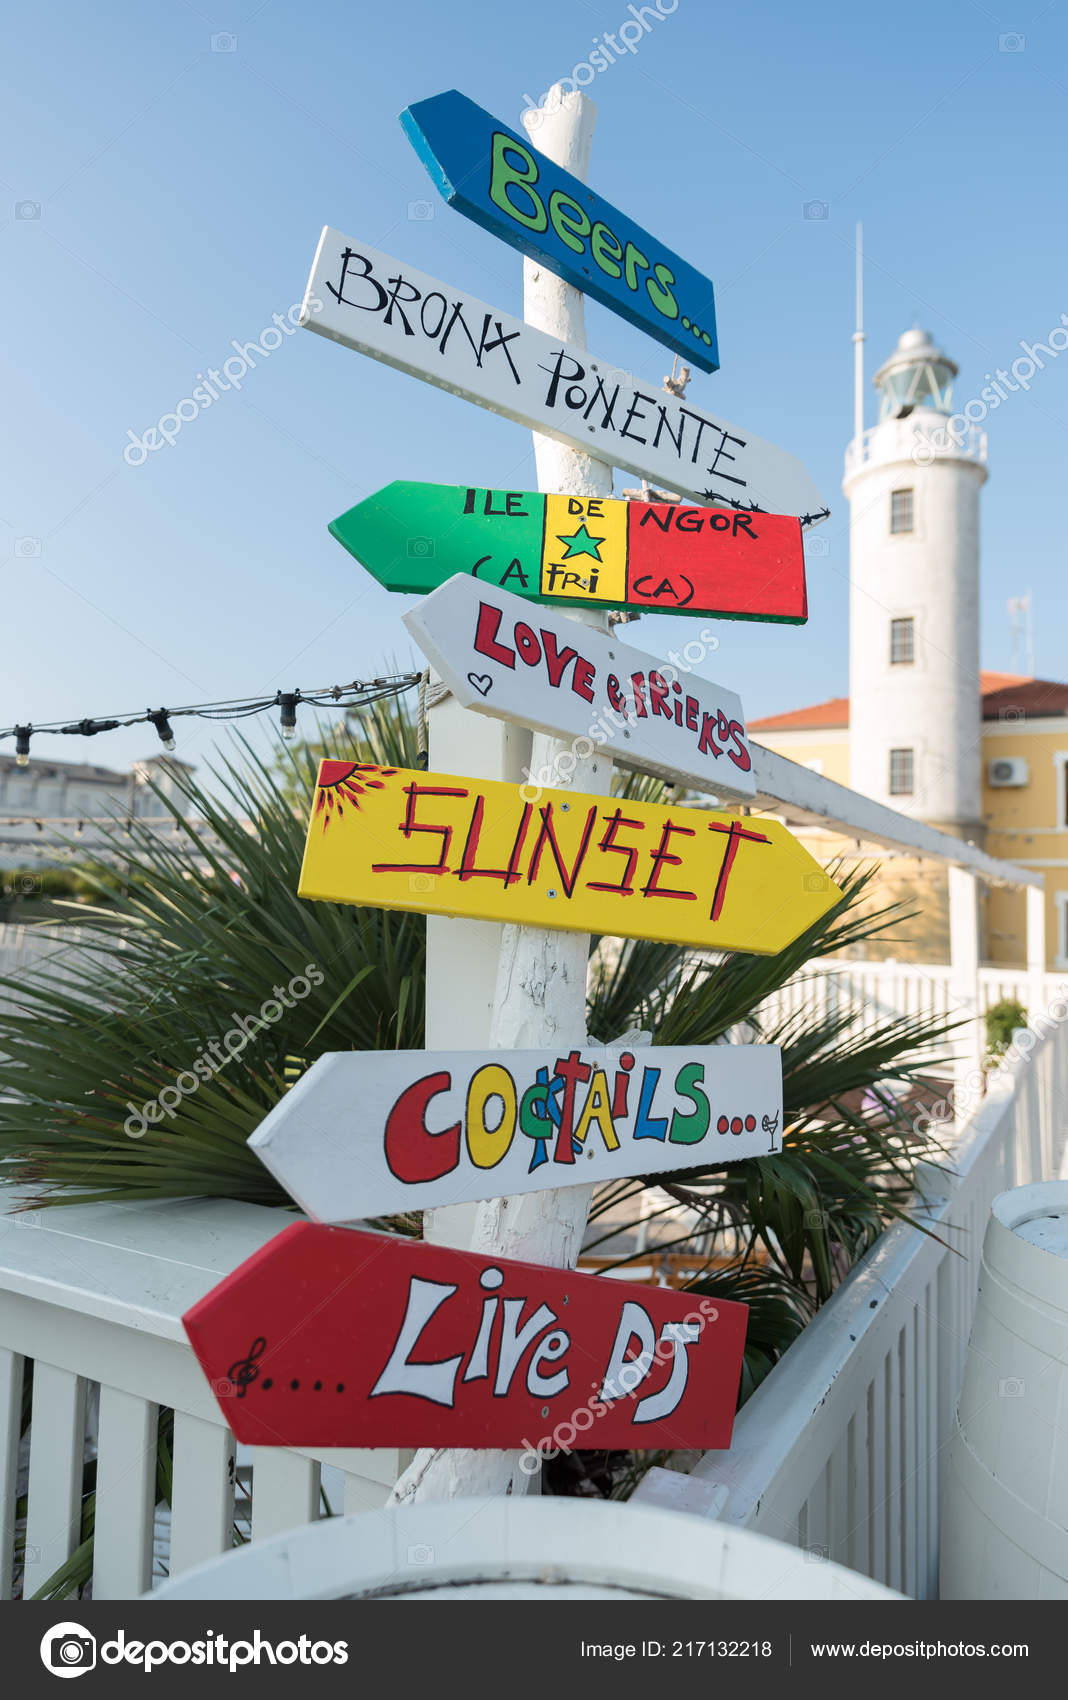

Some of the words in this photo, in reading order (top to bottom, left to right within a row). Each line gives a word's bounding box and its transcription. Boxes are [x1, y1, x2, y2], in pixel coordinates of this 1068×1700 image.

[326, 247, 521, 385] BRONX
[463, 488, 528, 517] ILE
[568, 498, 604, 518] DE
[639, 506, 758, 540] NGOR
[473, 601, 596, 704] LOVE
[371, 781, 773, 922] SUNSET
[597, 1300, 701, 1425] DJ
